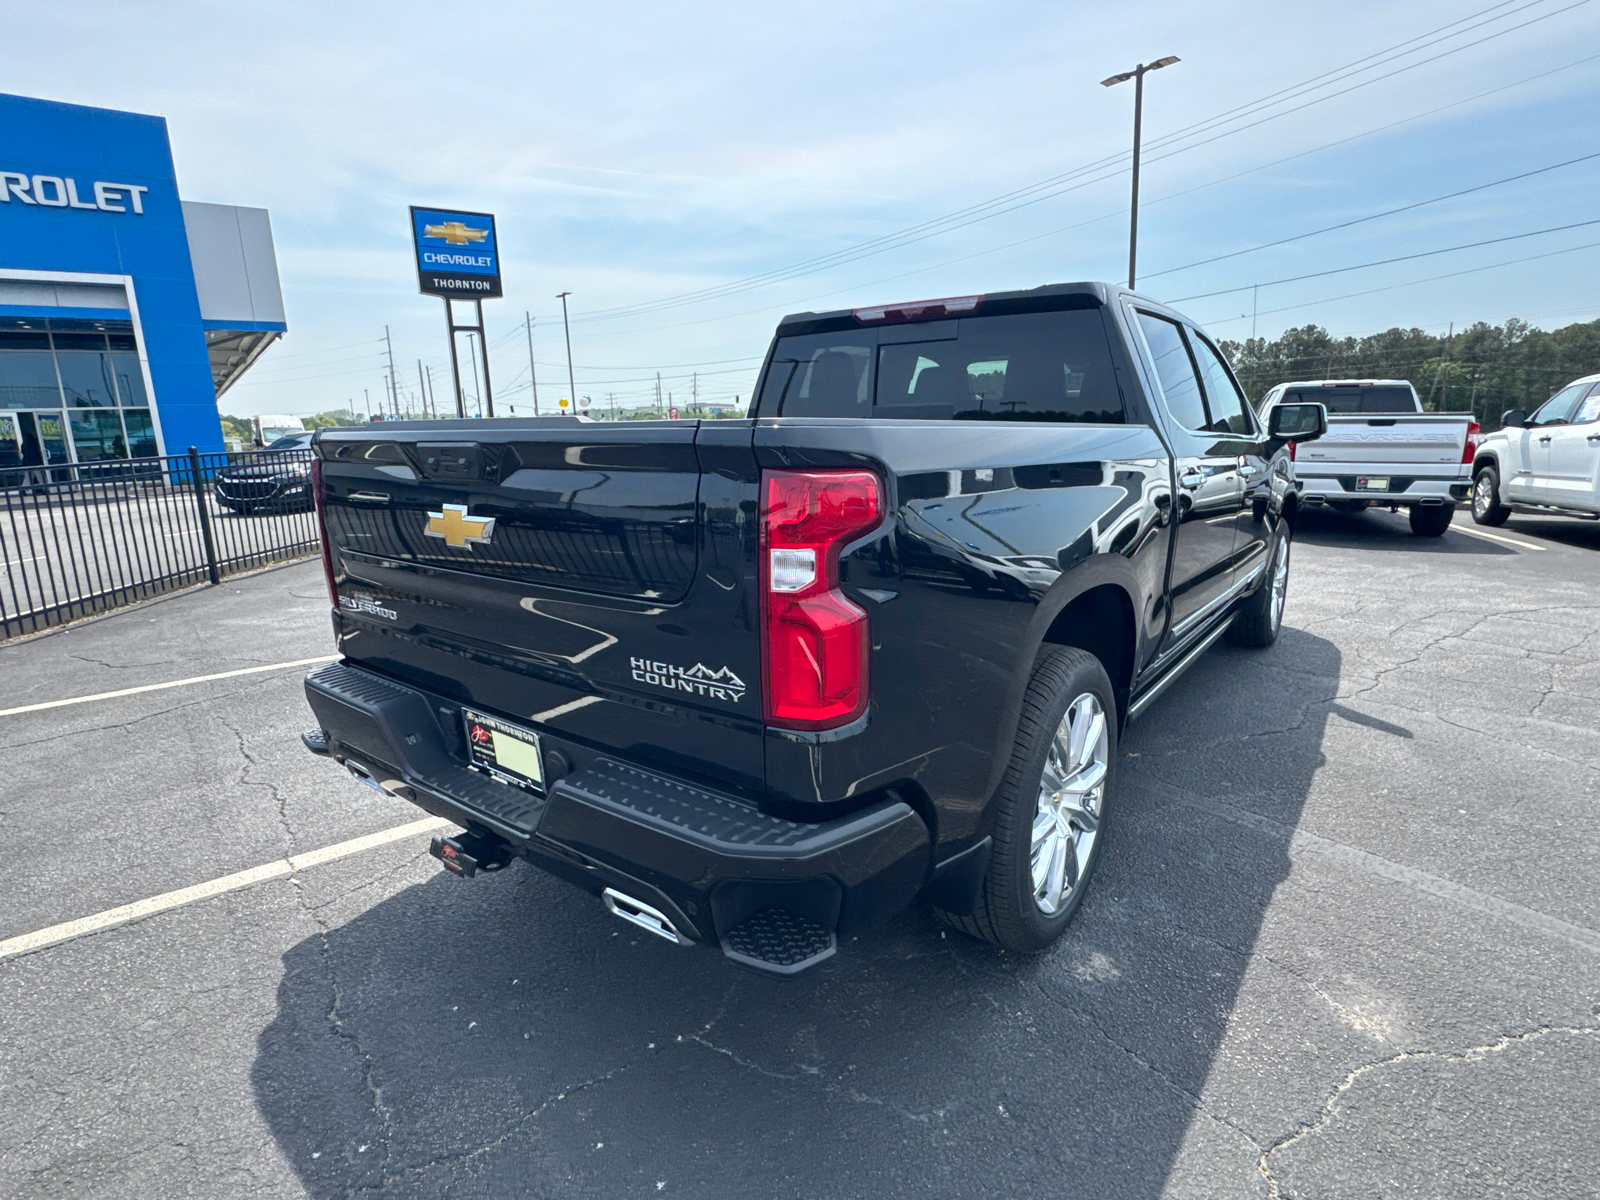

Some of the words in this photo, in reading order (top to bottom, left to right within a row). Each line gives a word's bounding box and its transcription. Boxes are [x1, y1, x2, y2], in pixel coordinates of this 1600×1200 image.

[423, 252, 492, 267] CHEVROLET
[433, 278, 490, 290] THORNTON
[1320, 433, 1455, 442] HEVROLET
[630, 656, 684, 678] HIGH
[632, 669, 746, 702] COUNTRY
[478, 715, 496, 729] JOHN
